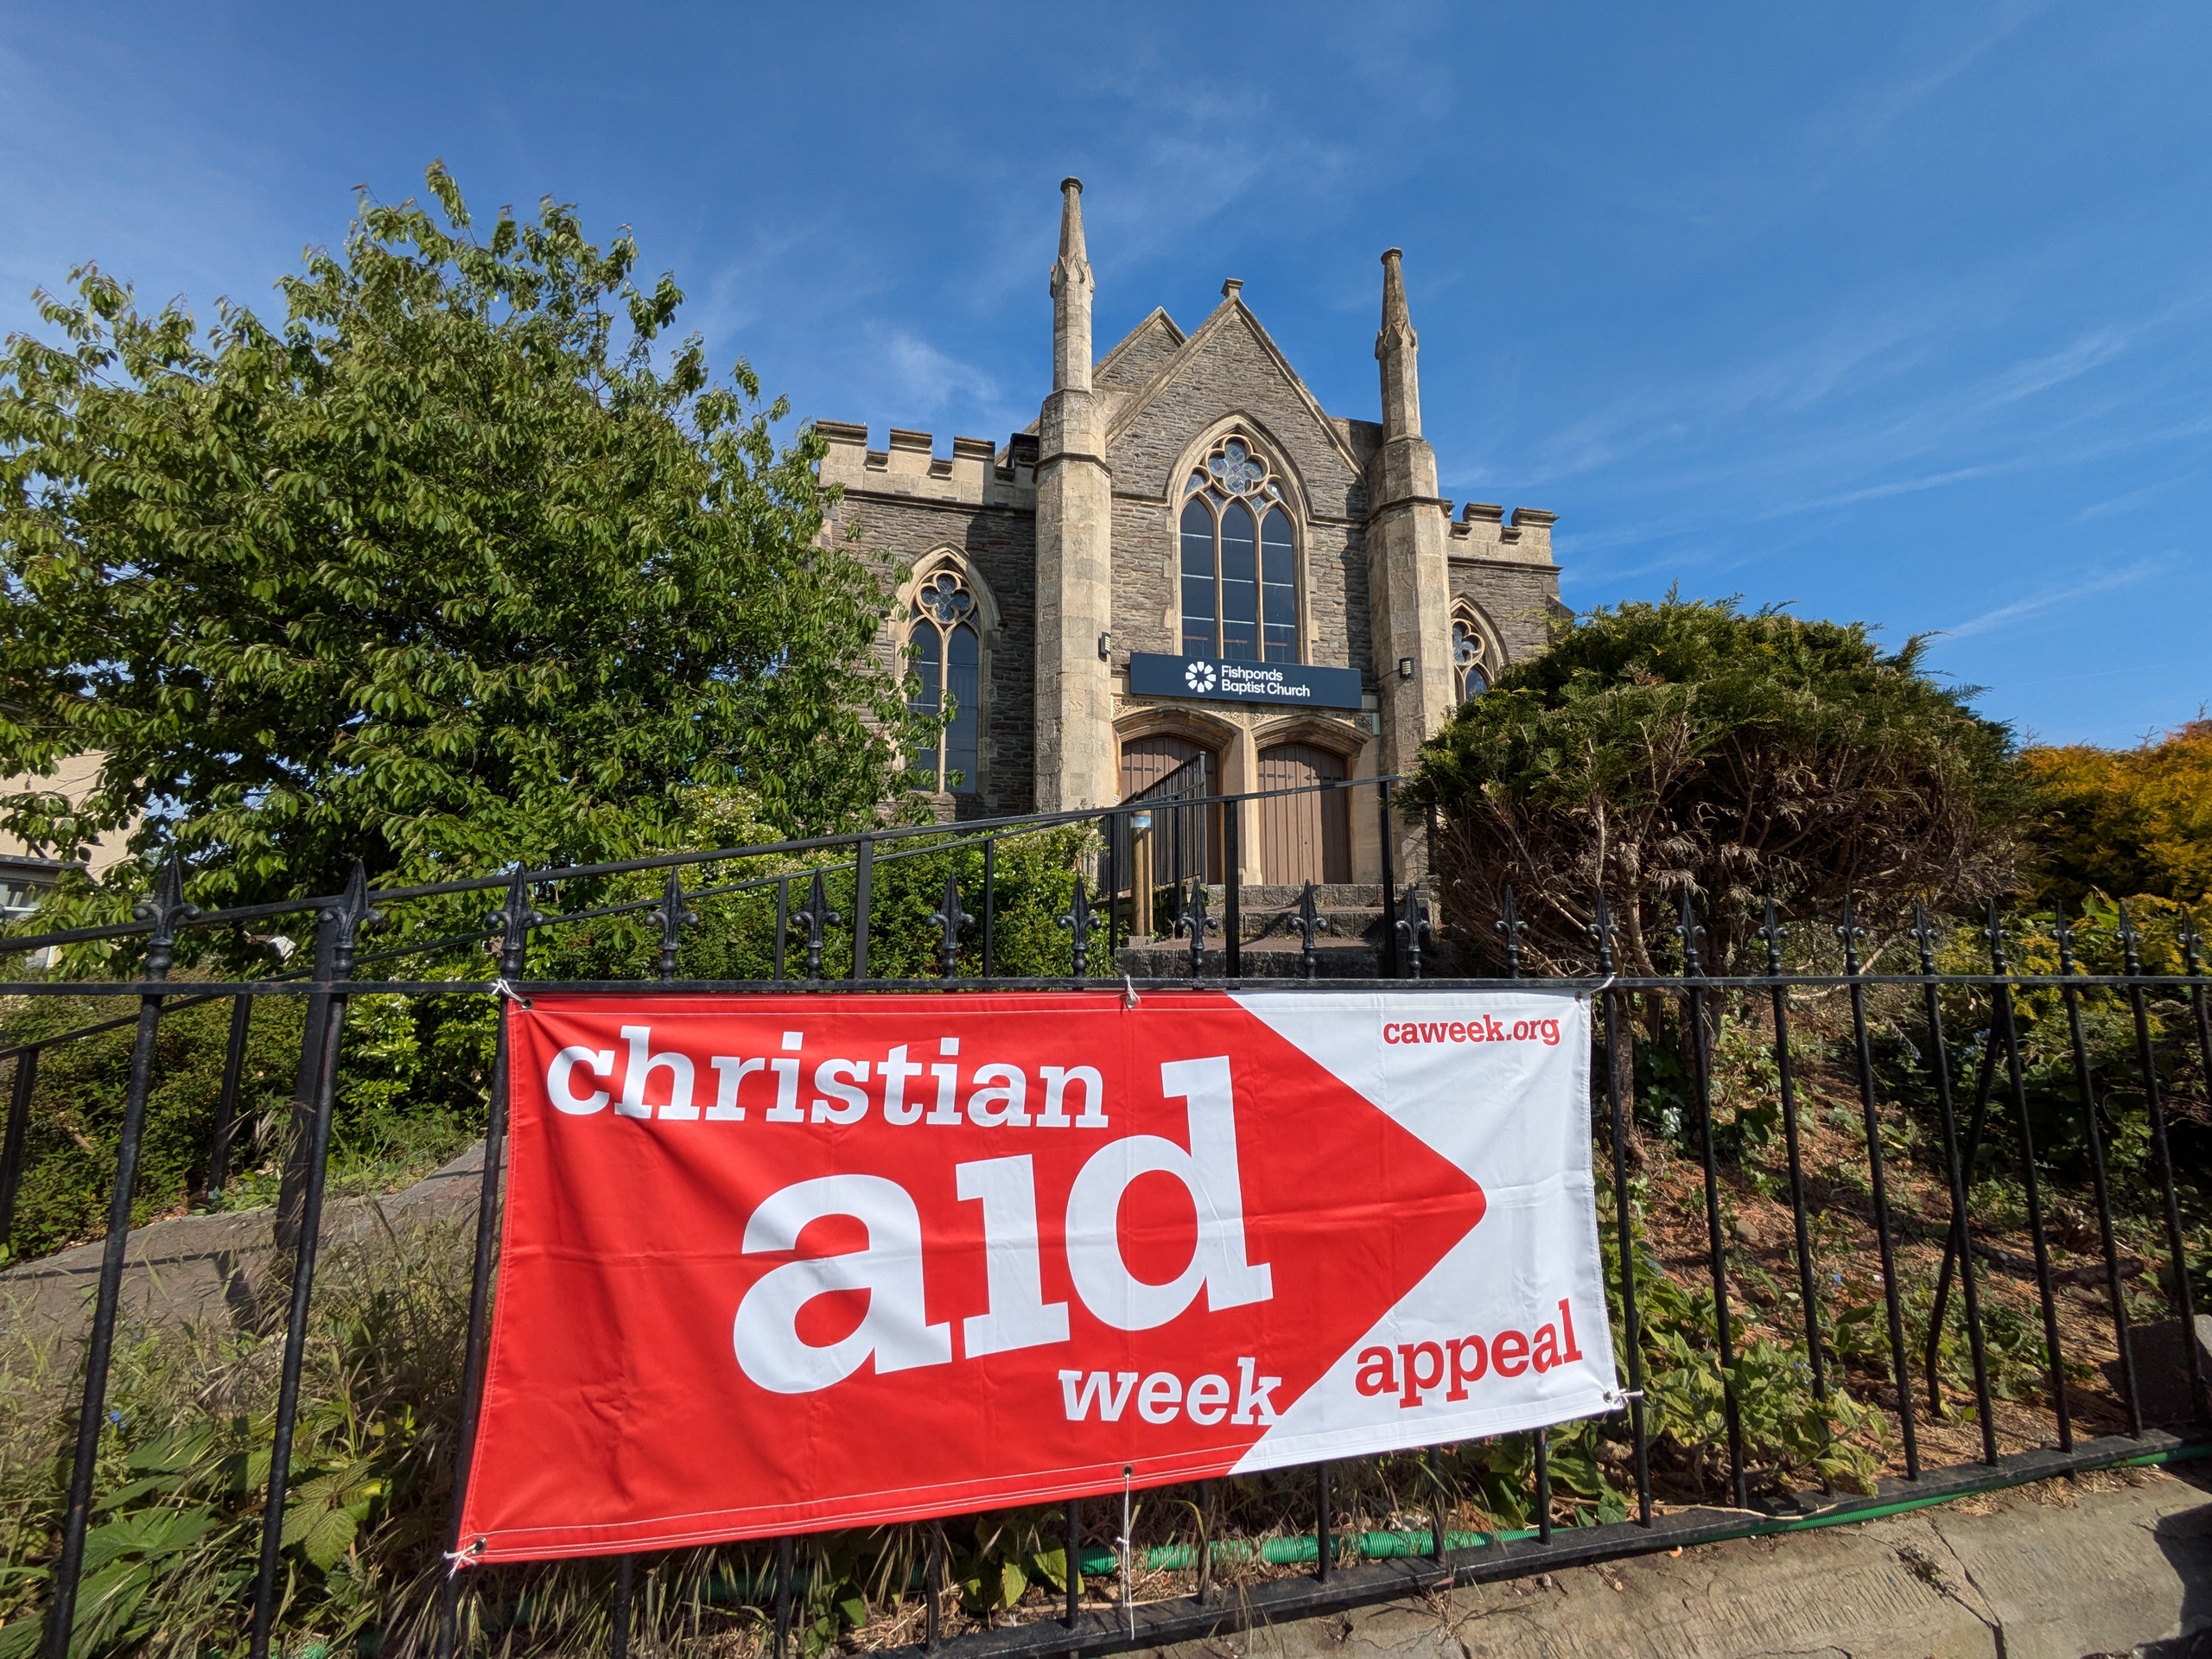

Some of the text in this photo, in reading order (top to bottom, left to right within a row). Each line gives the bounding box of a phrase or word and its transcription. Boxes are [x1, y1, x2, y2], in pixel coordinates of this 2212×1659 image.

[1221, 664, 1283, 681] Fishponds
[1221, 678, 1311, 697] Baptist Church
[1383, 1014, 1560, 1046] caweek.org
[546, 1026, 1109, 1128] christian
[733, 1055, 1274, 1395] aid
[1355, 1298, 1583, 1409] appeal
[1058, 1357, 1282, 1426] week
